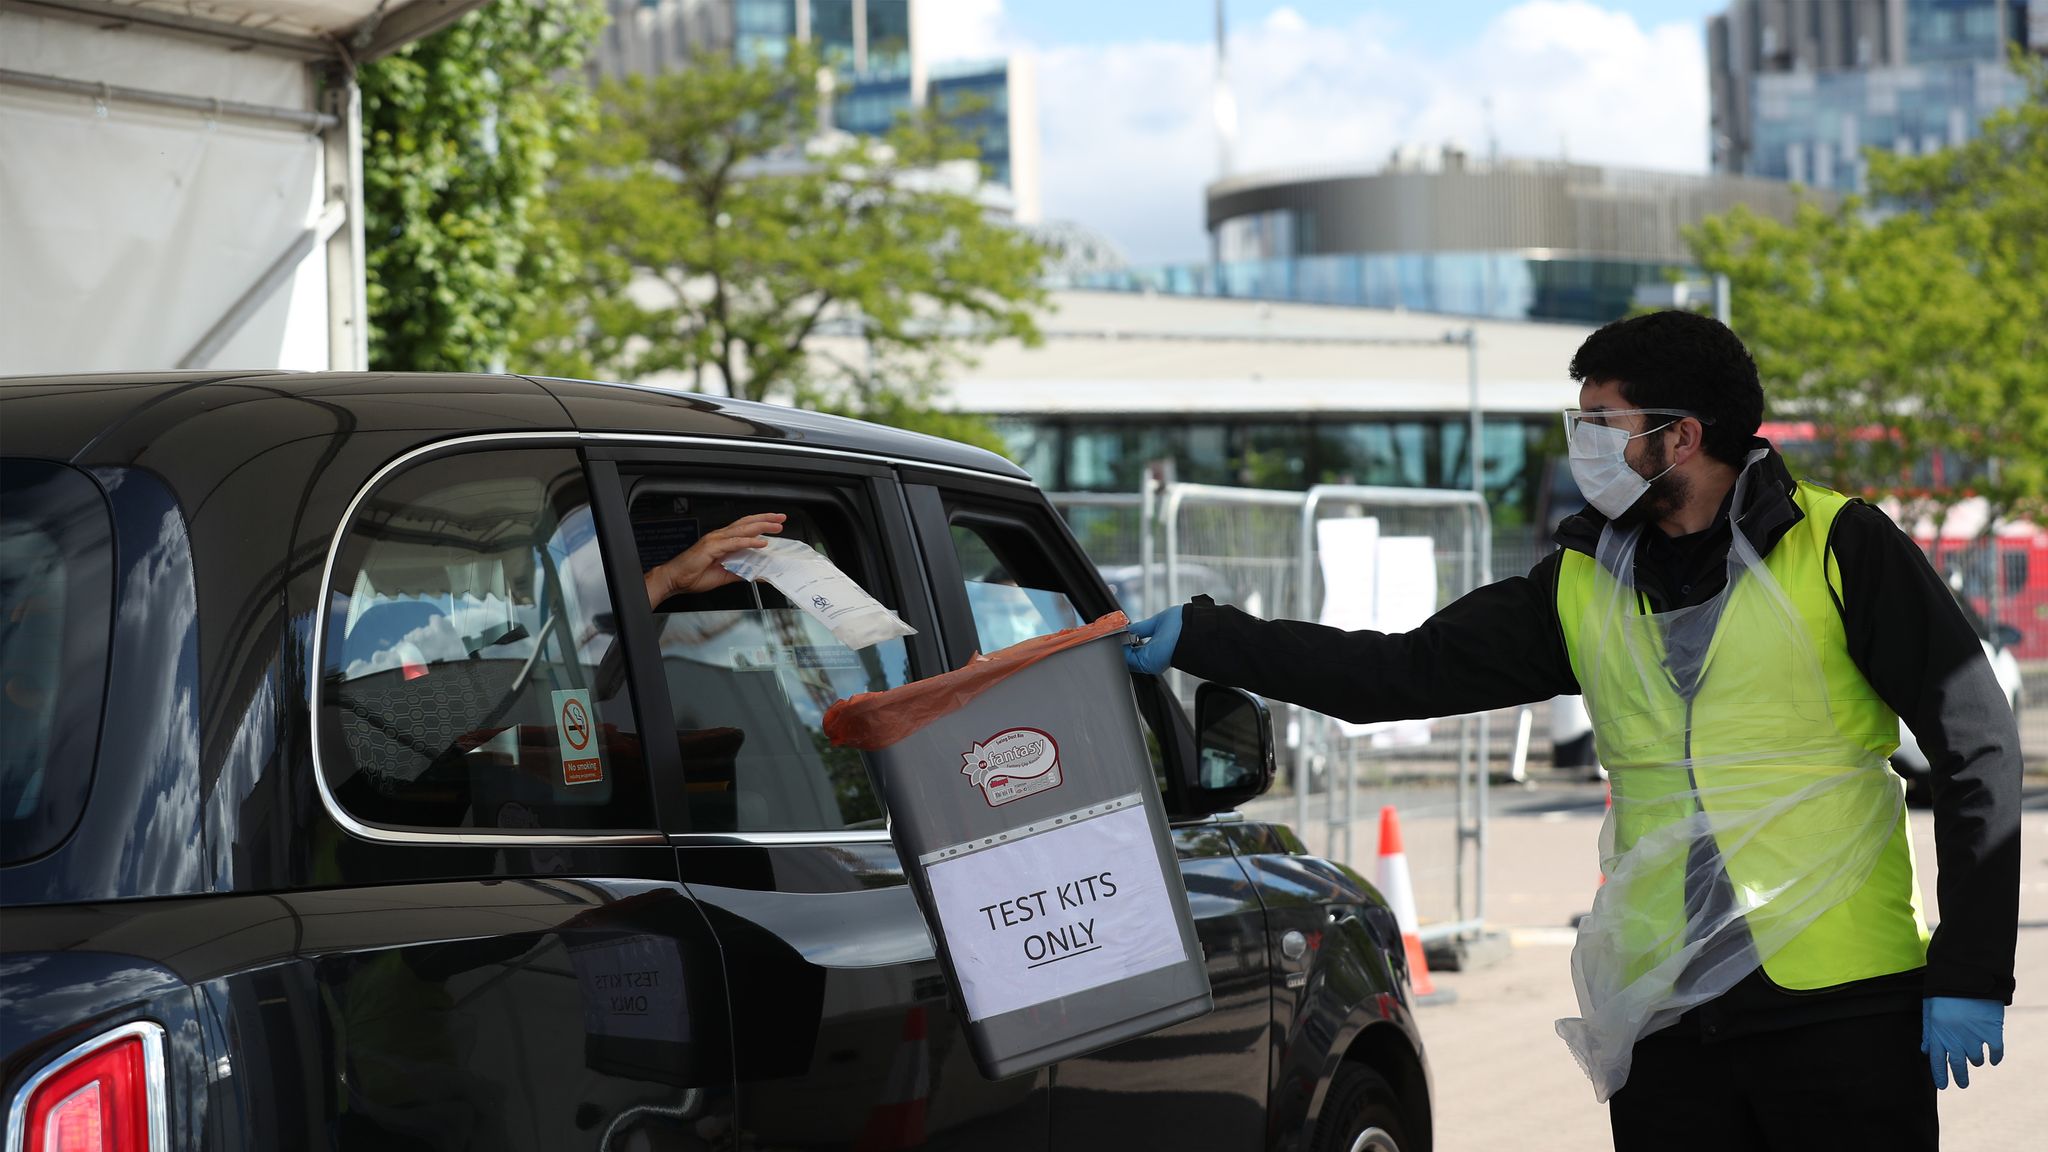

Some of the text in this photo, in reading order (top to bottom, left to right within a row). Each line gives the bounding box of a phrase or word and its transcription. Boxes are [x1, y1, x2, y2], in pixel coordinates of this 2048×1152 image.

[568, 761, 597, 771] No smoking
[988, 739, 1043, 768] fantasy
[979, 871, 1117, 931] TEST KITS
[1023, 918, 1095, 961] ONLY
